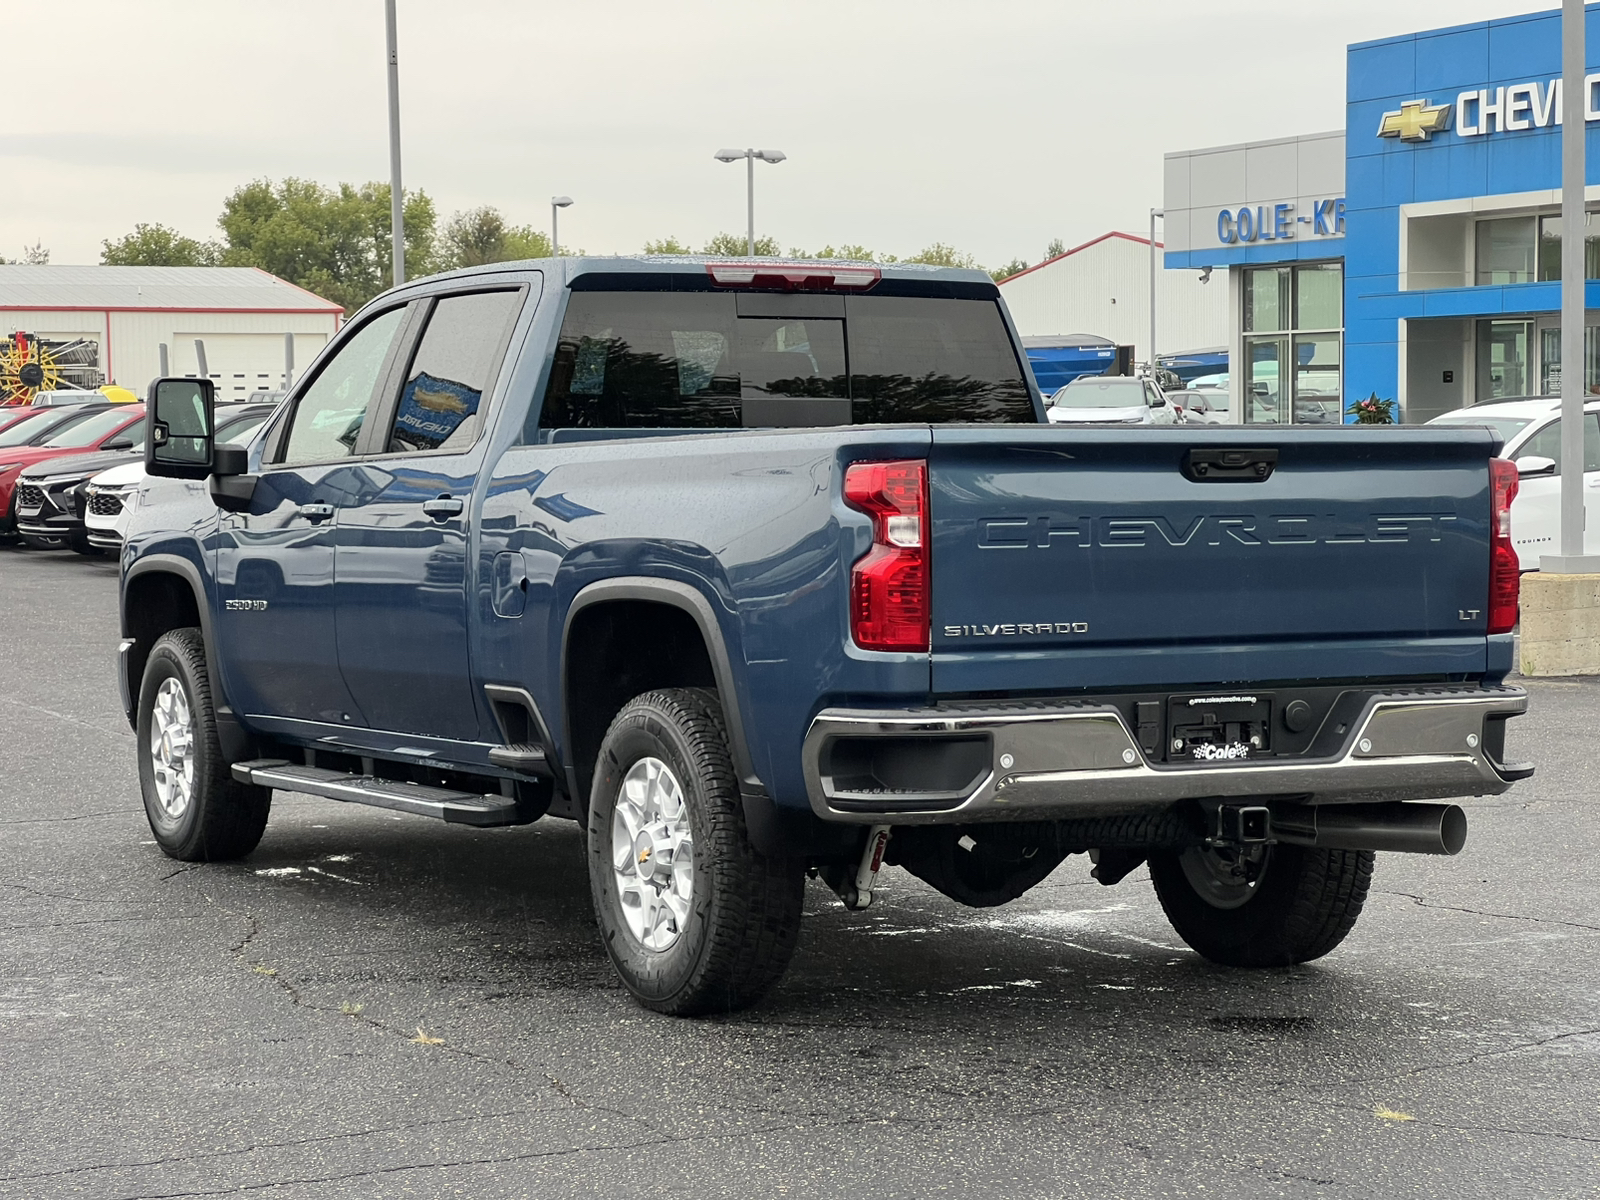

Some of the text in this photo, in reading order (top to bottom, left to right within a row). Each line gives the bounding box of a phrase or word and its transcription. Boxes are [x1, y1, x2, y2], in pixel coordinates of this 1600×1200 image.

[977, 512, 1457, 548] CHEVROLET
[1517, 536, 1551, 544] EQUINOX
[225, 599, 252, 610] 2500
[1459, 609, 1480, 620] LT
[944, 622, 1088, 637] SILVERADO
[1205, 744, 1237, 760] Cole
